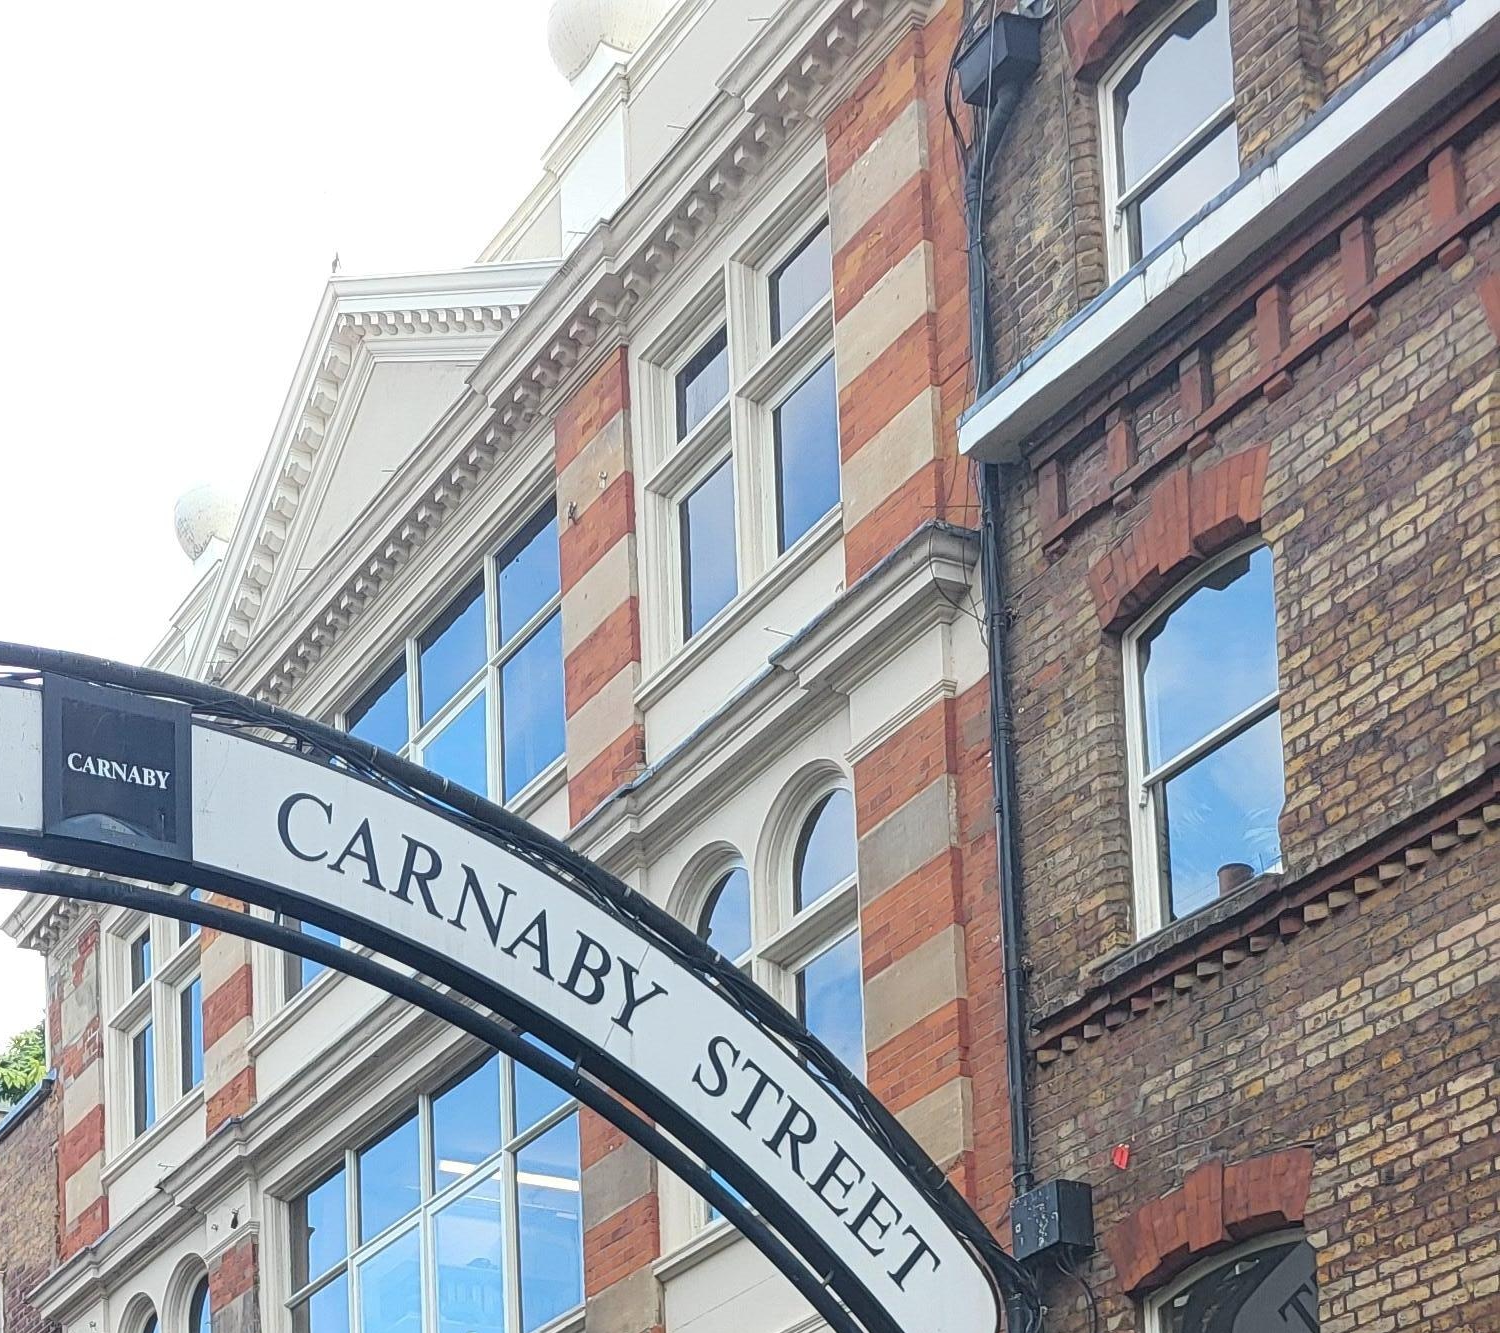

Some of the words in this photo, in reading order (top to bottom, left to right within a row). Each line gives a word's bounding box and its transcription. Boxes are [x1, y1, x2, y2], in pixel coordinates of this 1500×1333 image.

[67, 752, 171, 789] CARNABY
[277, 792, 669, 1035] CARNABY
[691, 1035, 941, 1292] STREET
